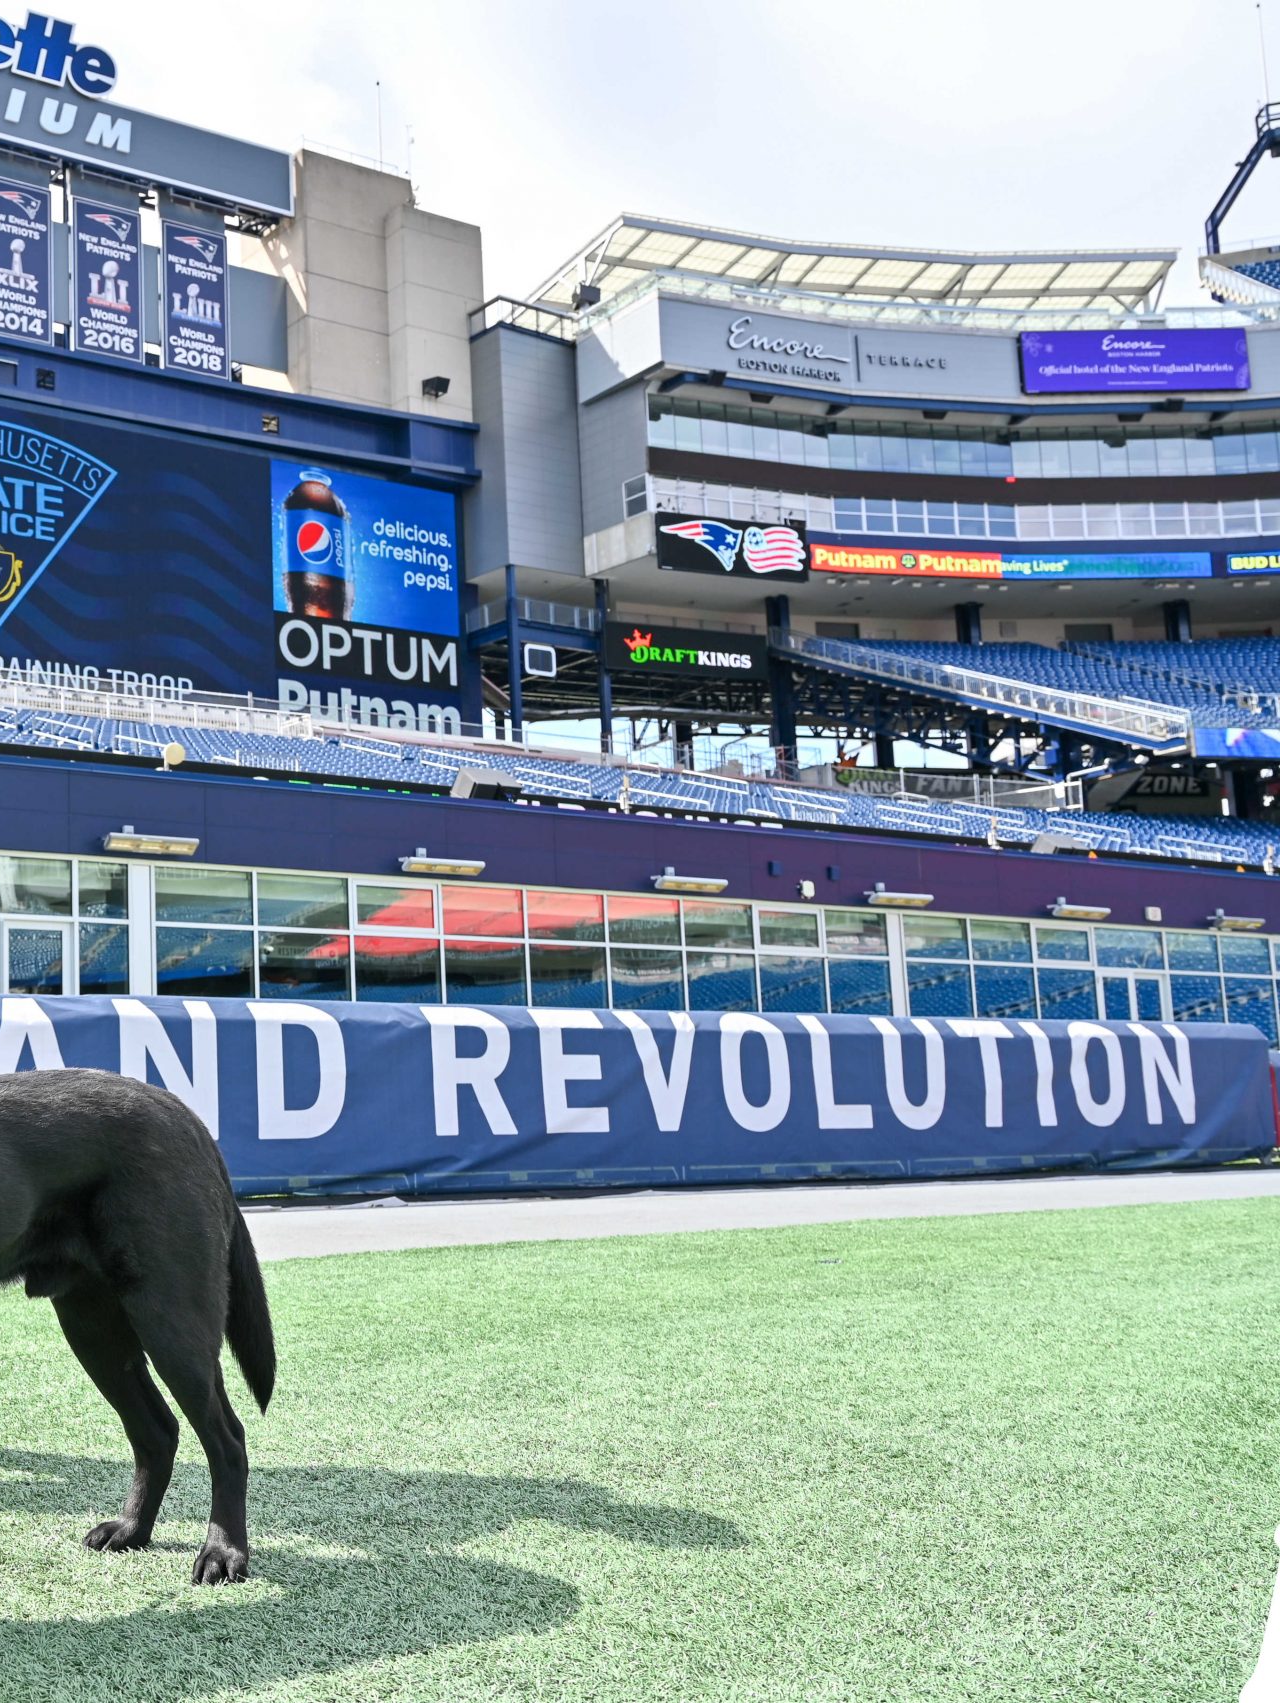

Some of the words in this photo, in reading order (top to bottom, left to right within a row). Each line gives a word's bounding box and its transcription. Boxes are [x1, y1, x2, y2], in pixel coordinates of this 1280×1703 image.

[7, 214, 47, 232] ENGLAND
[78, 232, 99, 243] NEW
[100, 237, 137, 254] ENGLAND
[86, 243, 131, 262] PATRIOTS
[168, 254, 187, 265] NEW
[188, 258, 224, 275] ENGLAND
[174, 263, 218, 282] PATRIOTS
[90, 307, 128, 325] WORLD
[79, 317, 138, 338] CHAMPIONS
[179, 326, 215, 343] WORLD
[83, 330, 135, 354] 2016
[169, 335, 225, 357] CHAMPIONS
[729, 316, 850, 364] Encore
[1101, 334, 1166, 351] Encore
[173, 347, 222, 372] 2018
[738, 358, 788, 375] BOSTON
[791, 366, 841, 382] HARBOR
[867, 354, 948, 370] TERRACE
[1039, 365, 1072, 376] Official
[1073, 364, 1099, 374] hotel
[1110, 364, 1127, 373] the
[1128, 364, 1150, 374] New
[1152, 363, 1194, 375] England
[1195, 362, 1234, 373] Patriots
[373, 518, 452, 548] delicious.
[333, 527, 345, 568] pepsi
[360, 540, 453, 573] refreshing.
[815, 548, 897, 570] Putnam
[919, 554, 1002, 573] Putnam
[1231, 555, 1269, 571] BUD
[404, 570, 453, 592] pepsi.
[278, 619, 458, 687] OPTUM
[630, 645, 752, 669] DRAFTKINGS
[107, 668, 193, 702] TROOP
[278, 678, 461, 736] Putnam
[1136, 776, 1202, 794] ZONE
[418, 1005, 1197, 1137] REVOLUTION
